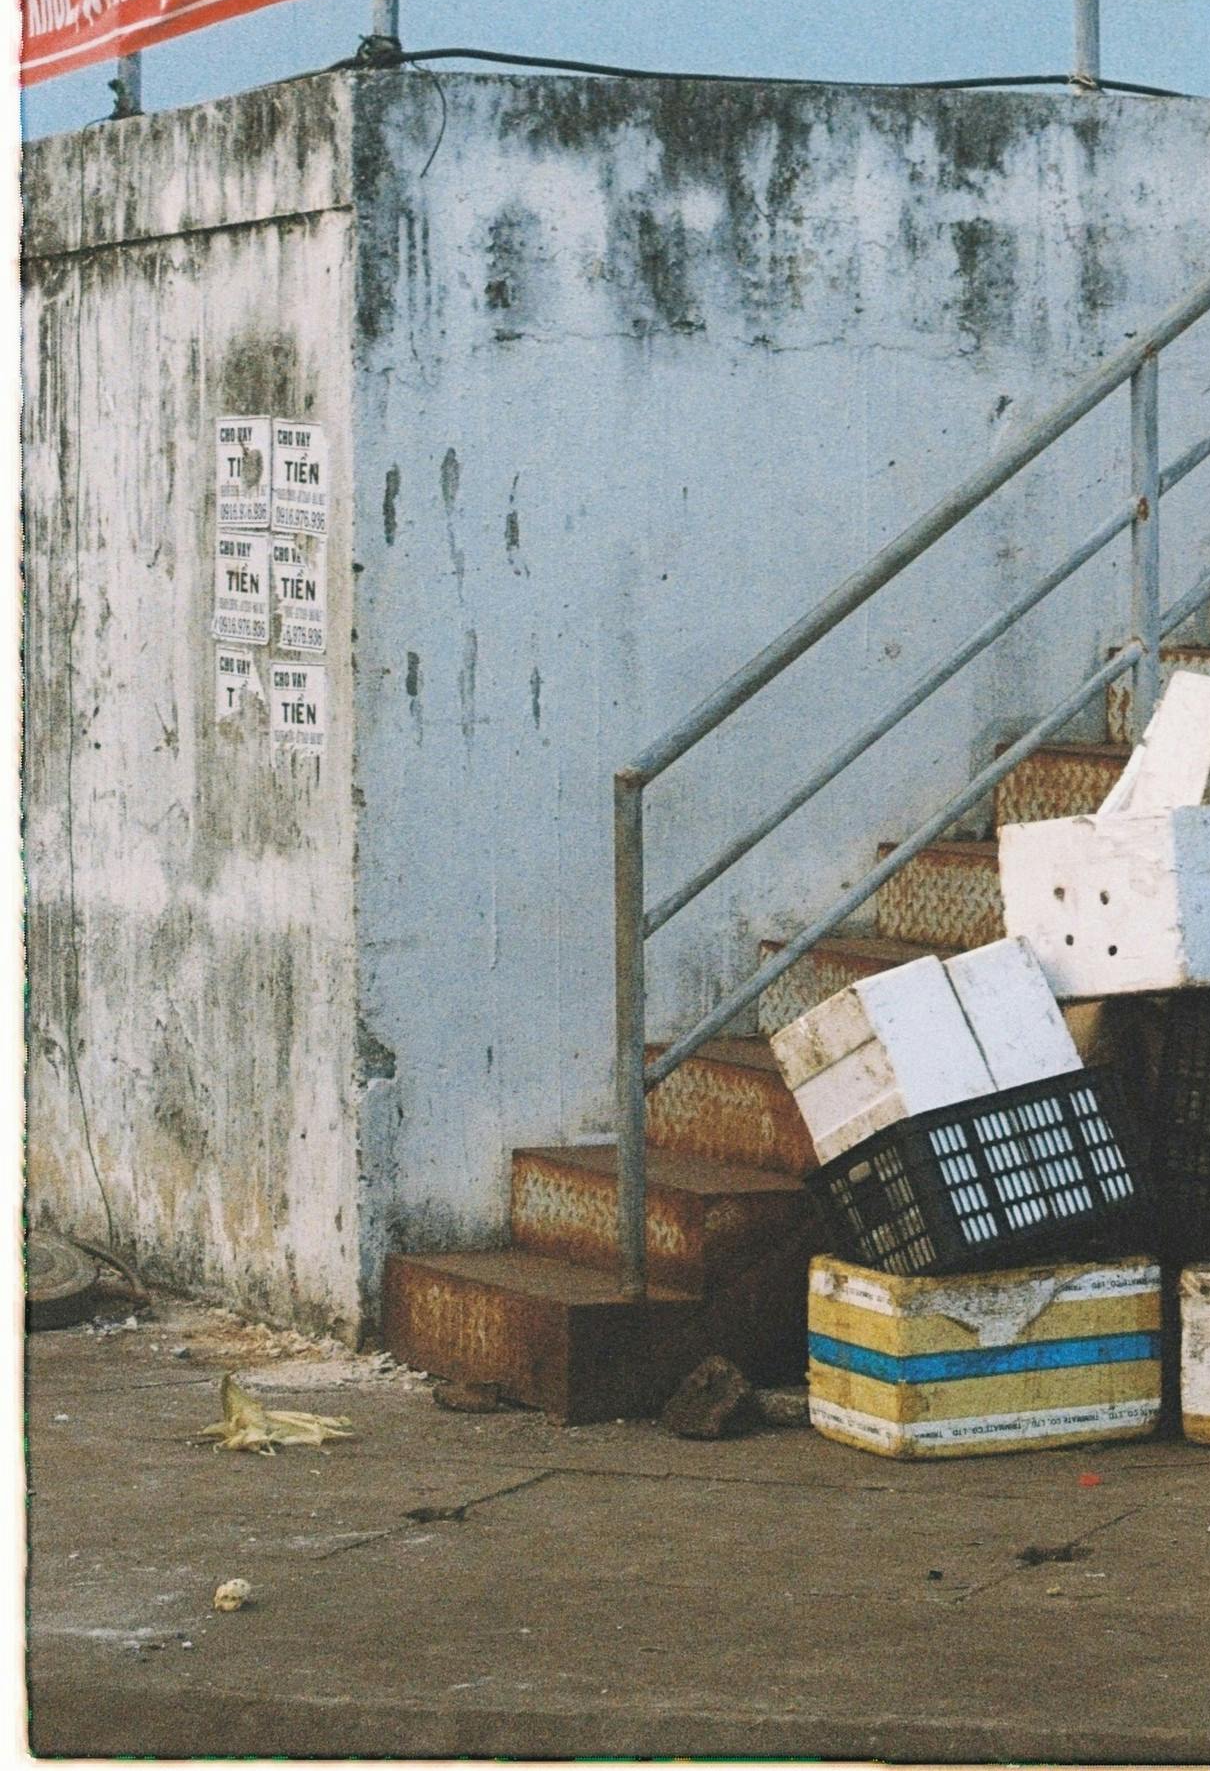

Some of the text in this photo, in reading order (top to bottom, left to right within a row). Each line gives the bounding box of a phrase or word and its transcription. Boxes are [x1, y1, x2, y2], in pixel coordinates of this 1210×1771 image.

[220, 427, 252, 442] CHO VAY
[278, 430, 311, 447] CHO VAY
[220, 540, 252, 557] CHO VAY
[274, 546, 289, 562] CHO
[220, 656, 251, 675] CHO VAY
[274, 672, 307, 688] CHO VAY
